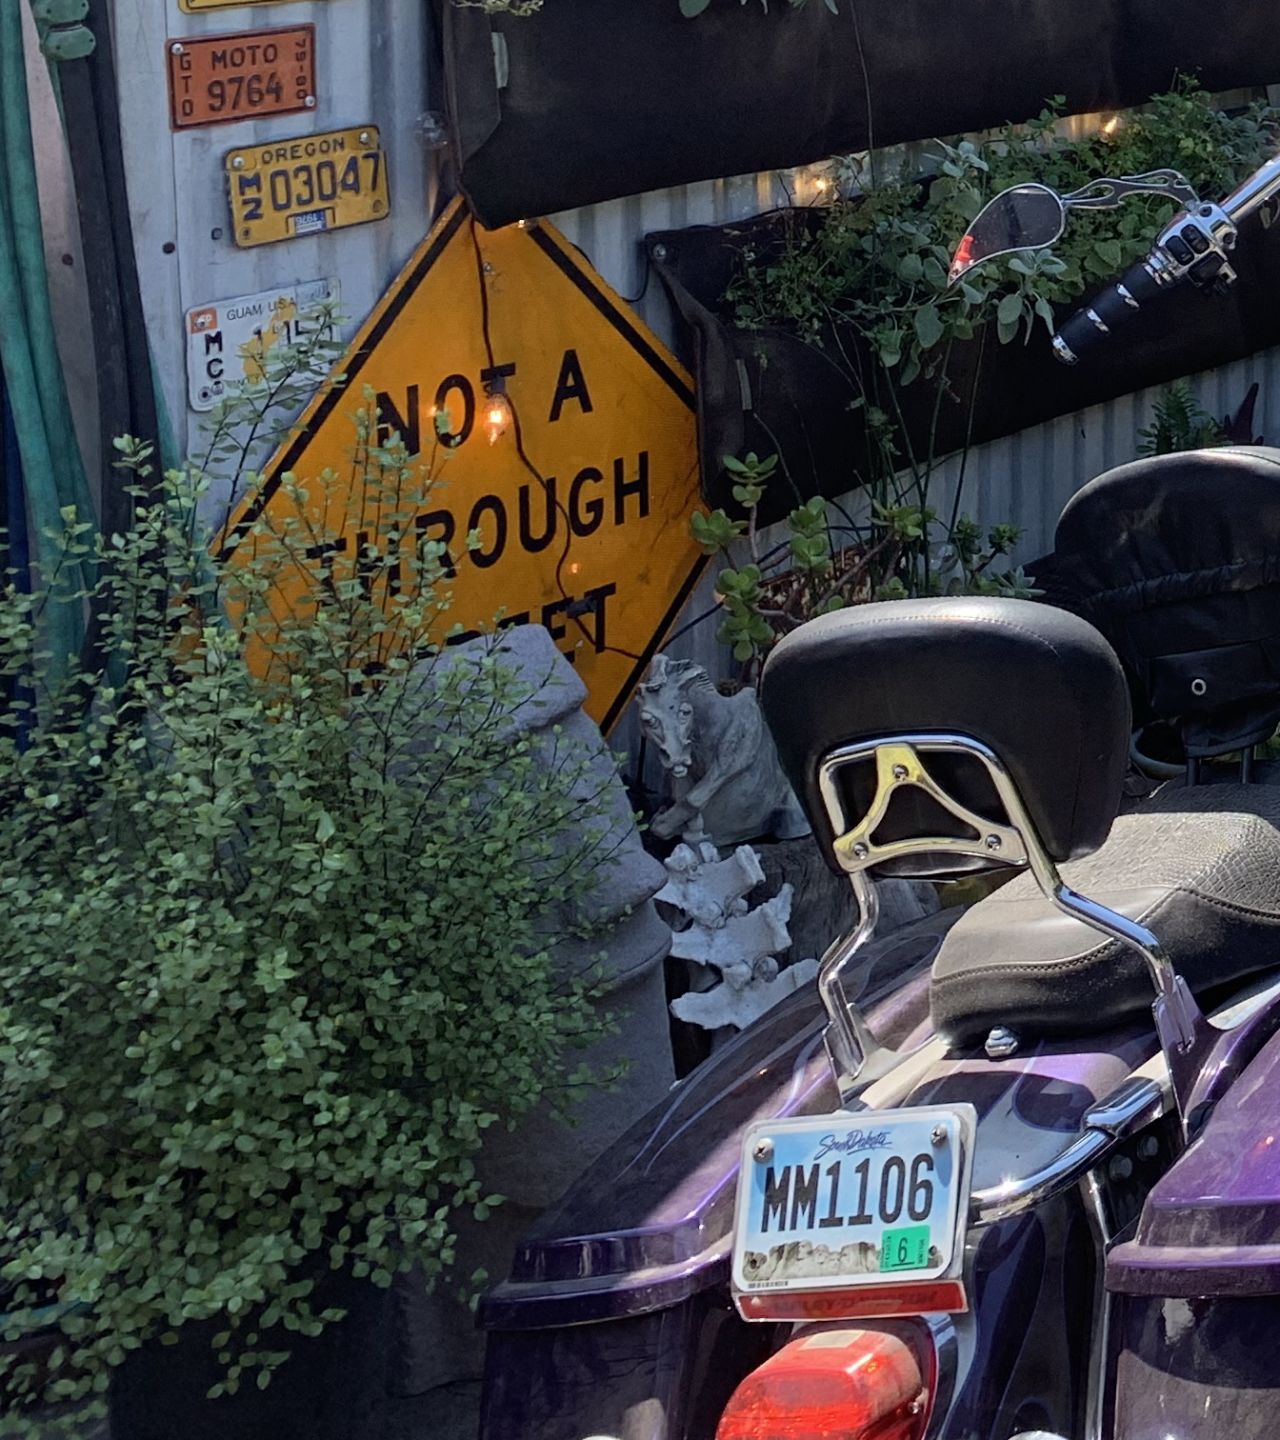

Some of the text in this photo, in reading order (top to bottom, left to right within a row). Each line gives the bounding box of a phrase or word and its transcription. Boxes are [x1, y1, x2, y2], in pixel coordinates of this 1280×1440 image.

[211, 42, 279, 71] MOTO
[207, 71, 284, 113] 9764
[261, 136, 346, 166] OREGON
[269, 152, 381, 212] 03047
[226, 295, 298, 321] GUAM USA
[375, 348, 594, 457] NOT A
[305, 450, 650, 603] THROUGH
[846, 1129, 894, 1156] Dakota
[760, 1153, 935, 1234] MM1106
[896, 1237, 909, 1263] 6
